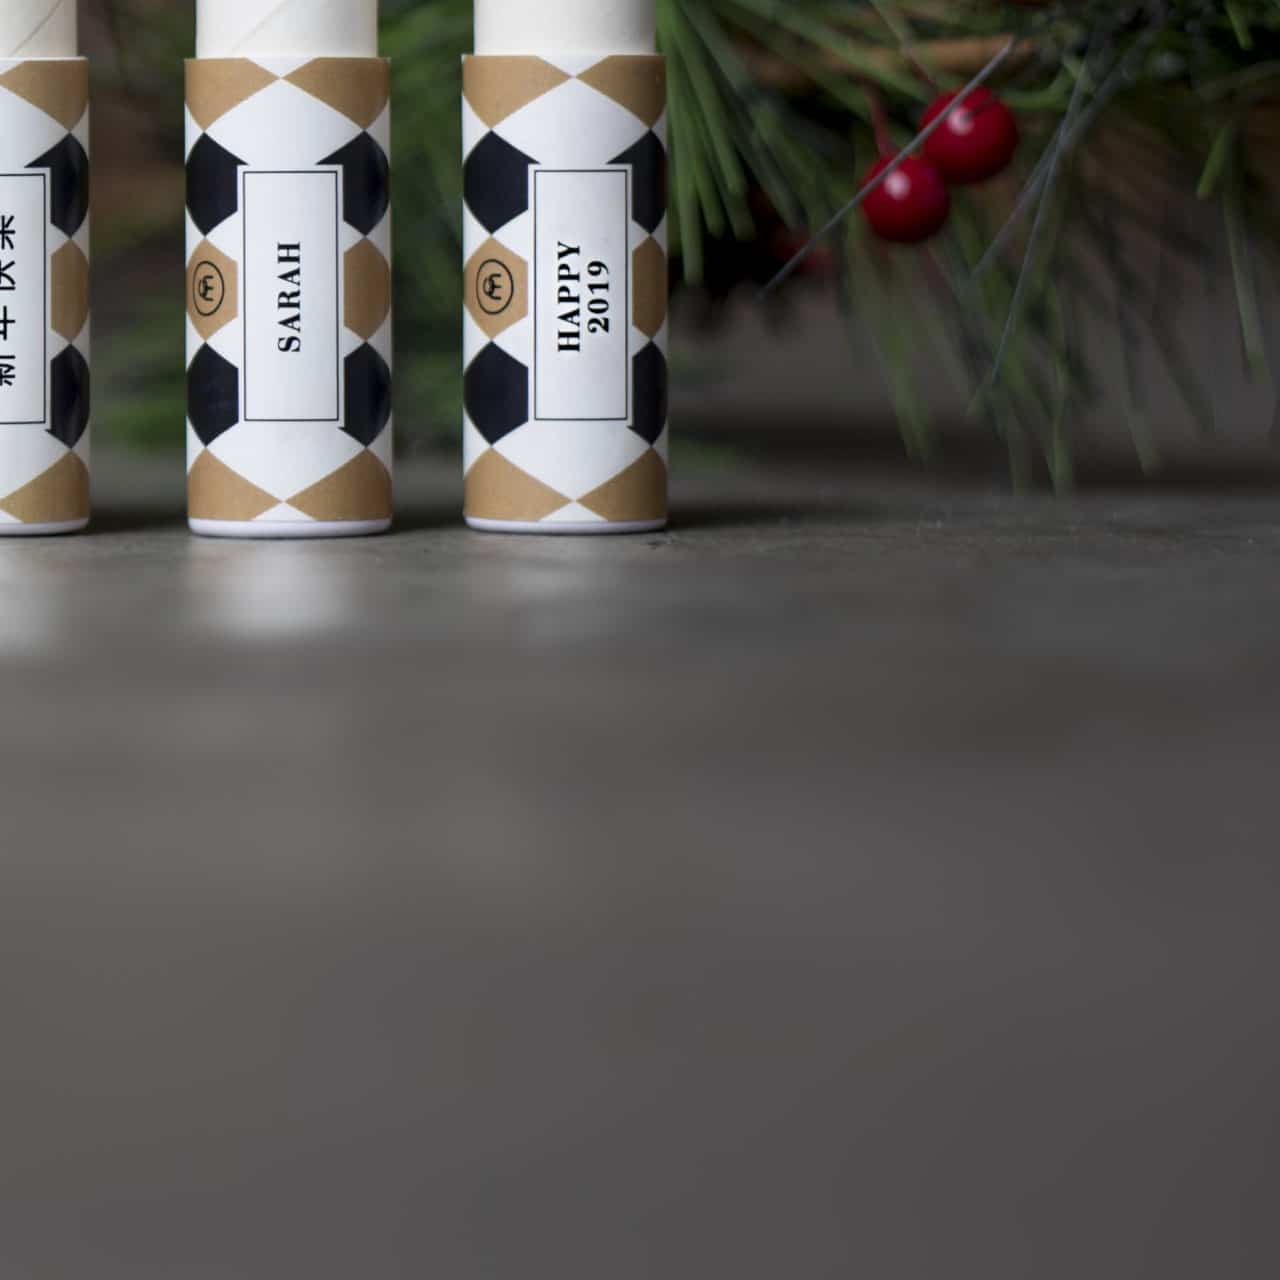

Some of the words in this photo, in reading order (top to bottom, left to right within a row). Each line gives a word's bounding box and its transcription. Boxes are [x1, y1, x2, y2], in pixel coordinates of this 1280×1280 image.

[276, 242, 301, 353] SARAH
[556, 240, 581, 352] HAPPY
[586, 259, 610, 334] 2019
